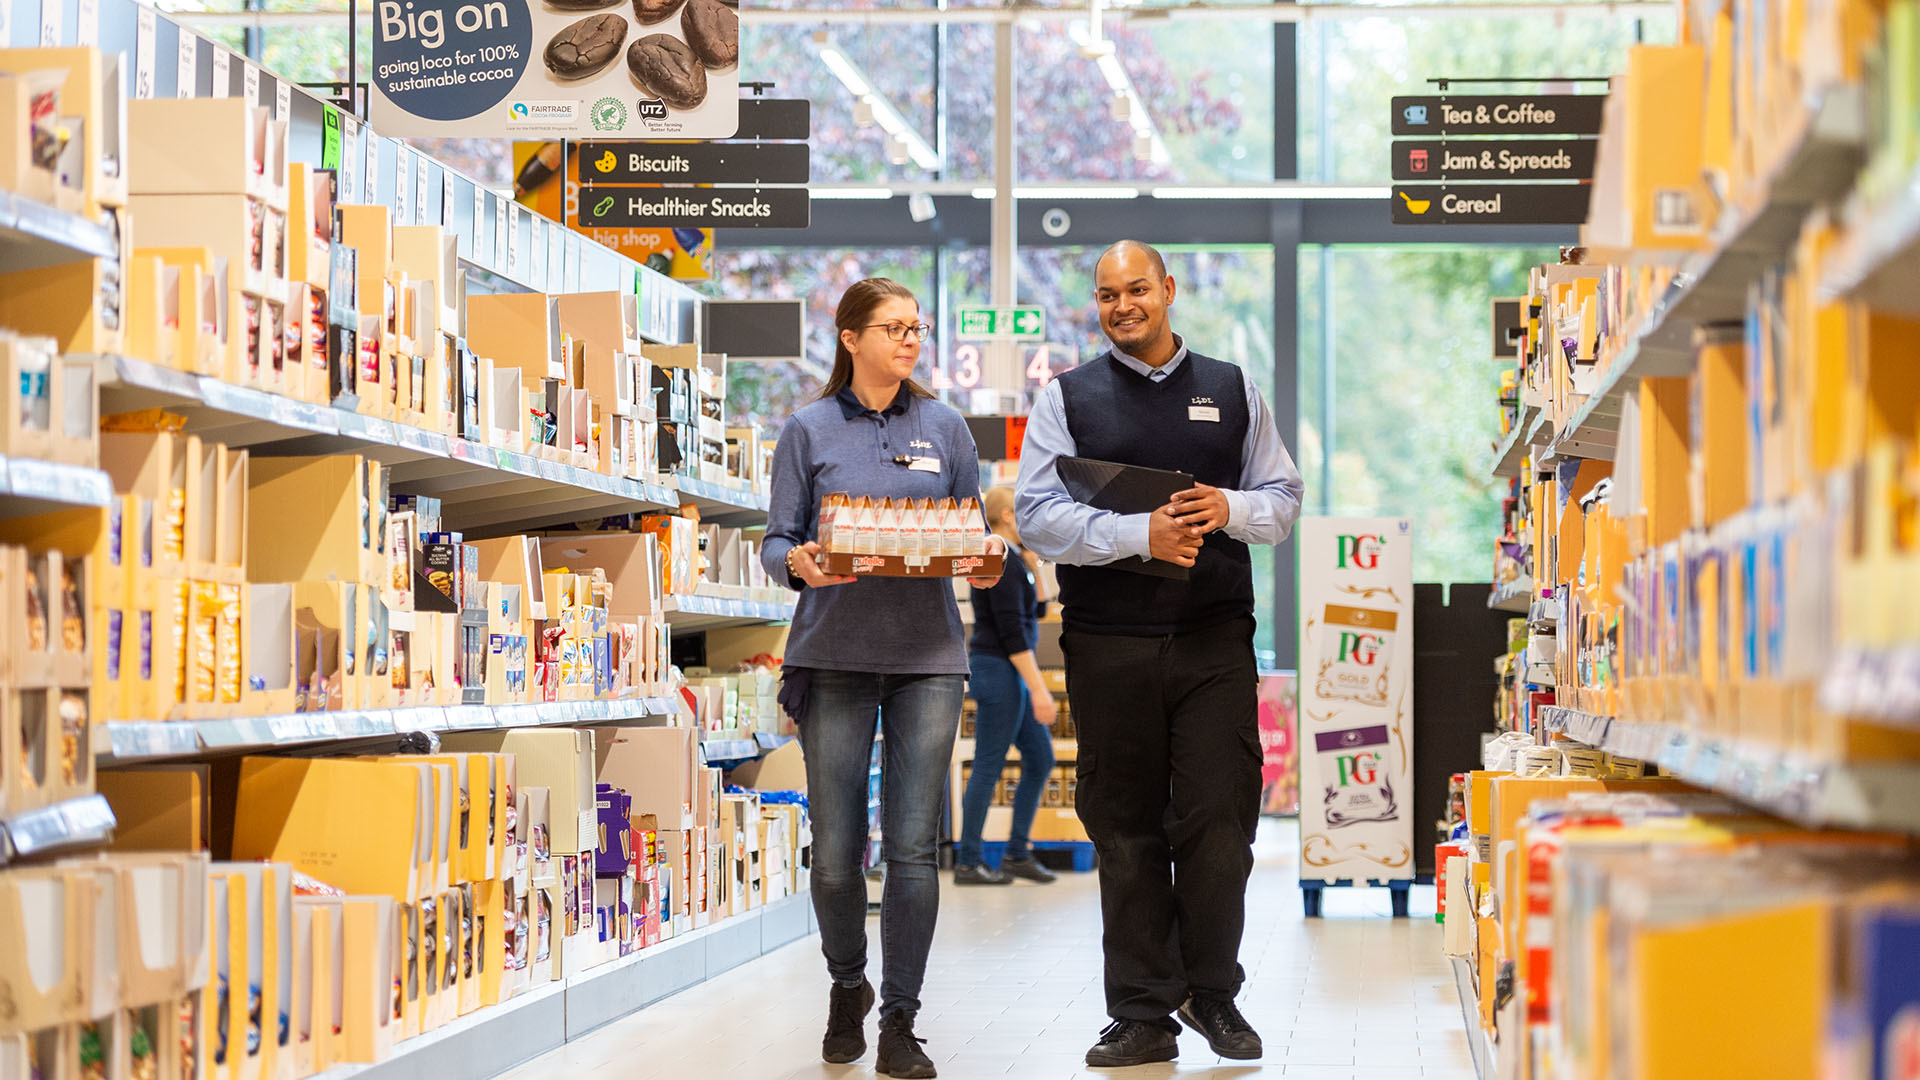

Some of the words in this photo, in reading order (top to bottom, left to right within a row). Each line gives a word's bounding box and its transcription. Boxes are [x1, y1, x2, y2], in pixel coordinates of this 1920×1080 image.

[378, 1, 446, 49] Big
[455, 1, 509, 33] on
[378, 59, 419, 79] going
[421, 54, 453, 70] loco
[454, 50, 477, 66] for
[478, 43, 520, 63] 100%
[388, 70, 467, 93] sustainable
[469, 67, 514, 82] cocoa
[531, 105, 572, 113] FAIRTRADE
[641, 104, 664, 115] UTZ
[1440, 104, 1472, 124] Tea
[1475, 104, 1491, 124] &
[1493, 103, 1556, 124] Coffee
[629, 153, 690, 172] Biscuits
[1440, 150, 1477, 170] Jam
[1479, 150, 1495, 170] &
[1499, 148, 1572, 174] Spreads
[628, 197, 708, 217] Healthier
[711, 197, 771, 217] Snacks
[1441, 193, 1501, 214] Cereal
[622, 228, 661, 250] shop
[955, 344, 981, 388] 3
[1026, 344, 1053, 387] 4
[853, 557, 885, 567] nutella
[952, 557, 983, 567] nutella
[1335, 534, 1380, 570] PG
[1335, 631, 1377, 667] PG
[1335, 753, 1377, 787] PG
